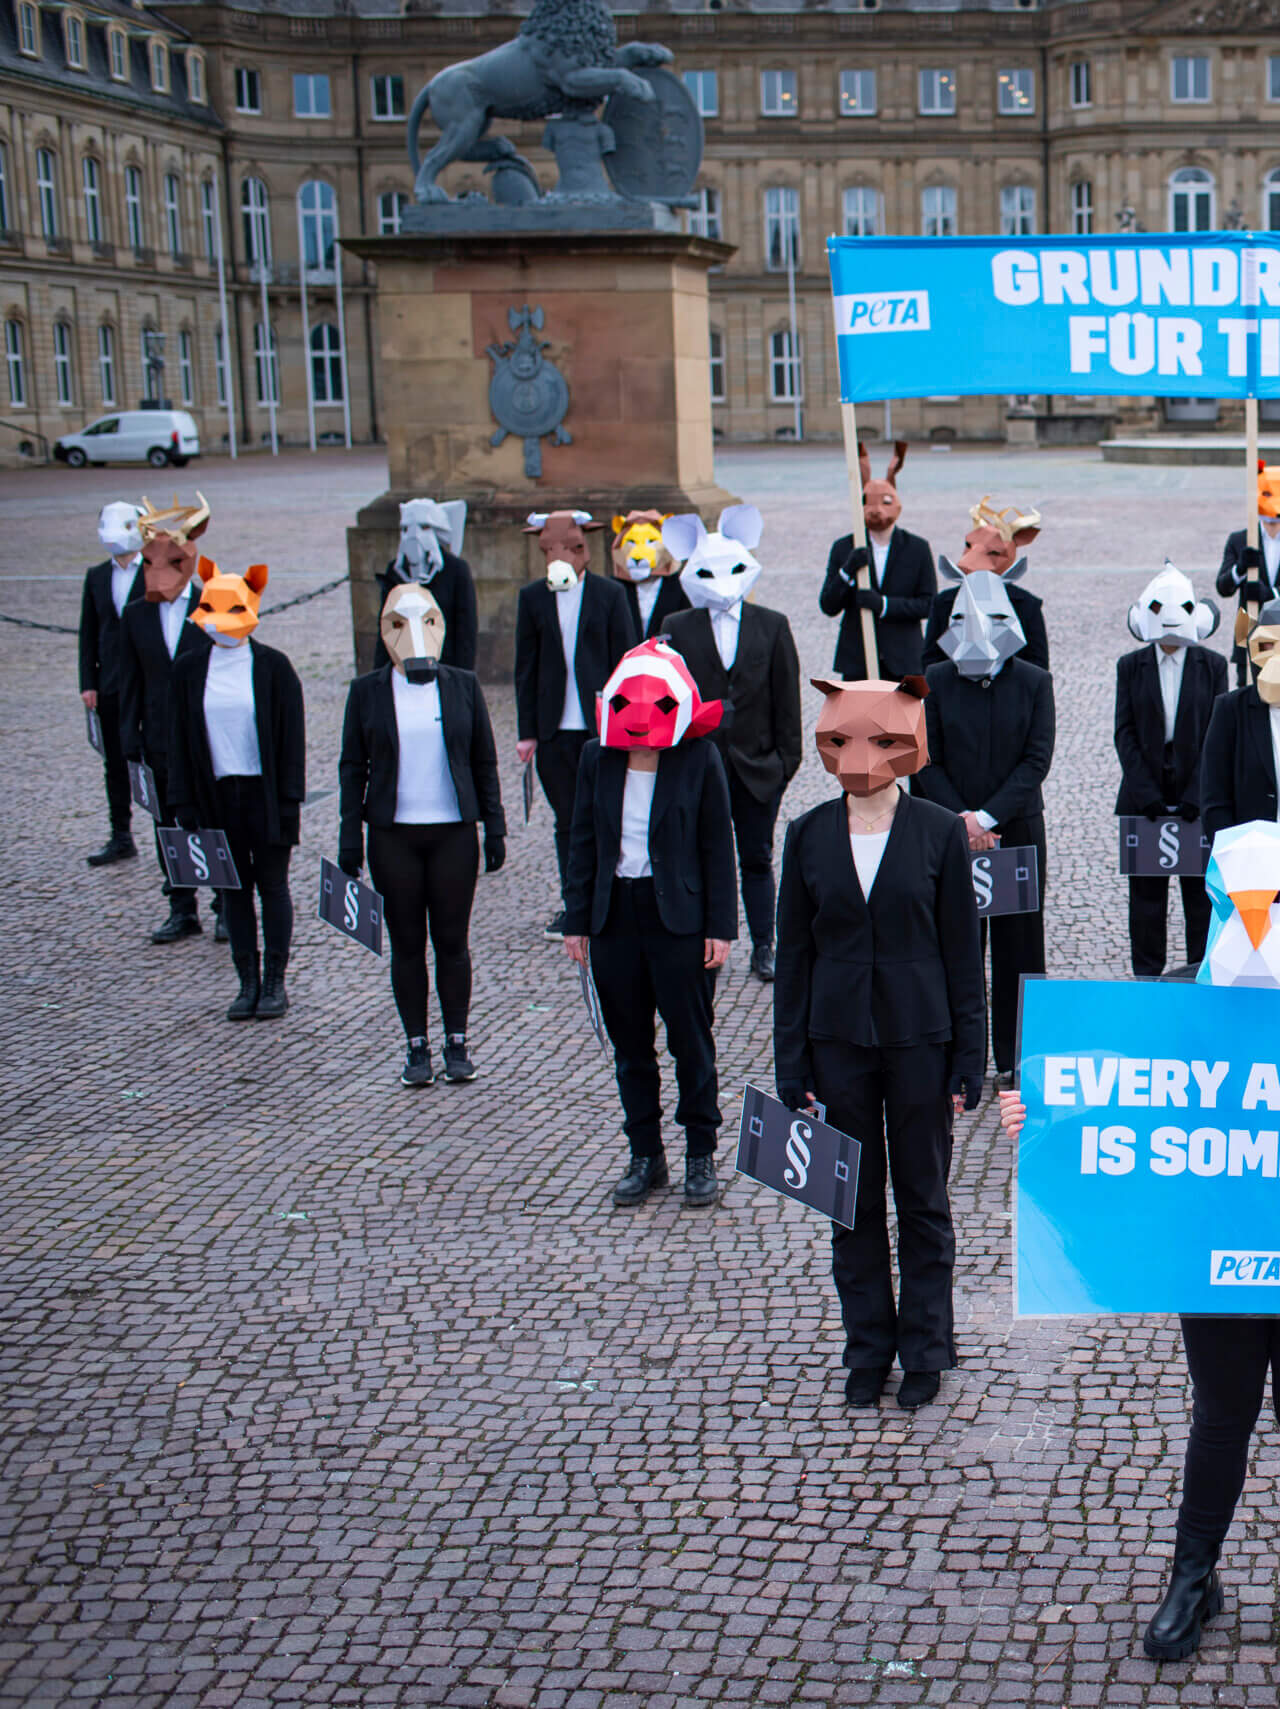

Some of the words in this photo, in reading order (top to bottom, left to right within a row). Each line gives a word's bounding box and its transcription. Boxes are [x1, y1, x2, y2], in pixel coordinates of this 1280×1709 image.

[1068, 311, 1203, 377] FÜR
[1043, 1055, 1230, 1109] EVERY
[1080, 1125, 1137, 1176] IS
